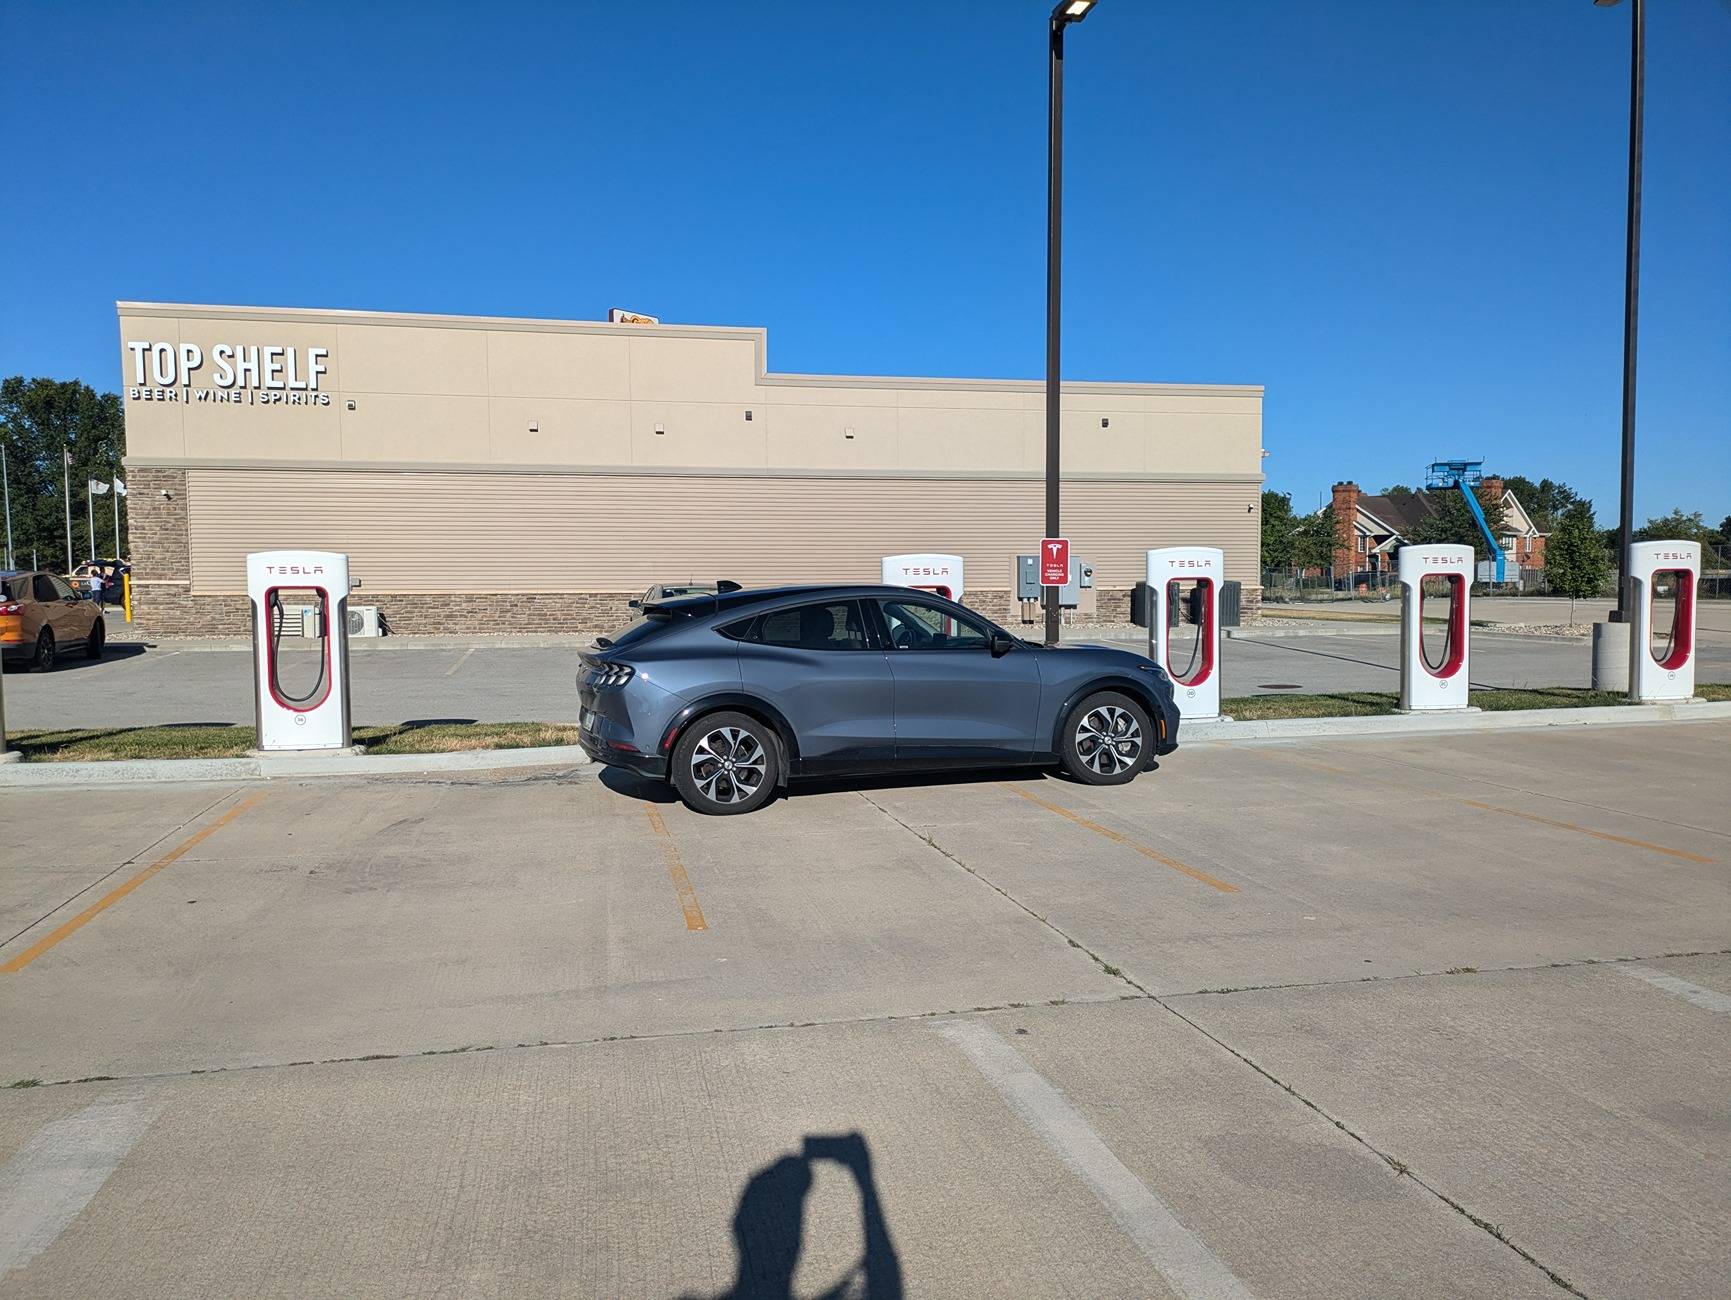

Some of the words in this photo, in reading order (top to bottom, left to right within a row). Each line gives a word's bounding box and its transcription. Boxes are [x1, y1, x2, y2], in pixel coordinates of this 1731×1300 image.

[127, 341, 203, 387] TOP
[212, 343, 328, 391] SHELF
[129, 387, 178, 401] BEER
[194, 389, 242, 403] WINE
[259, 391, 330, 406] SPIRITS
[1422, 556, 1464, 564] TESLA
[1653, 552, 1693, 560] TESLA
[1168, 560, 1212, 568] TESLA
[265, 566, 324, 575] TESLA
[902, 567, 949, 576] TESLA
